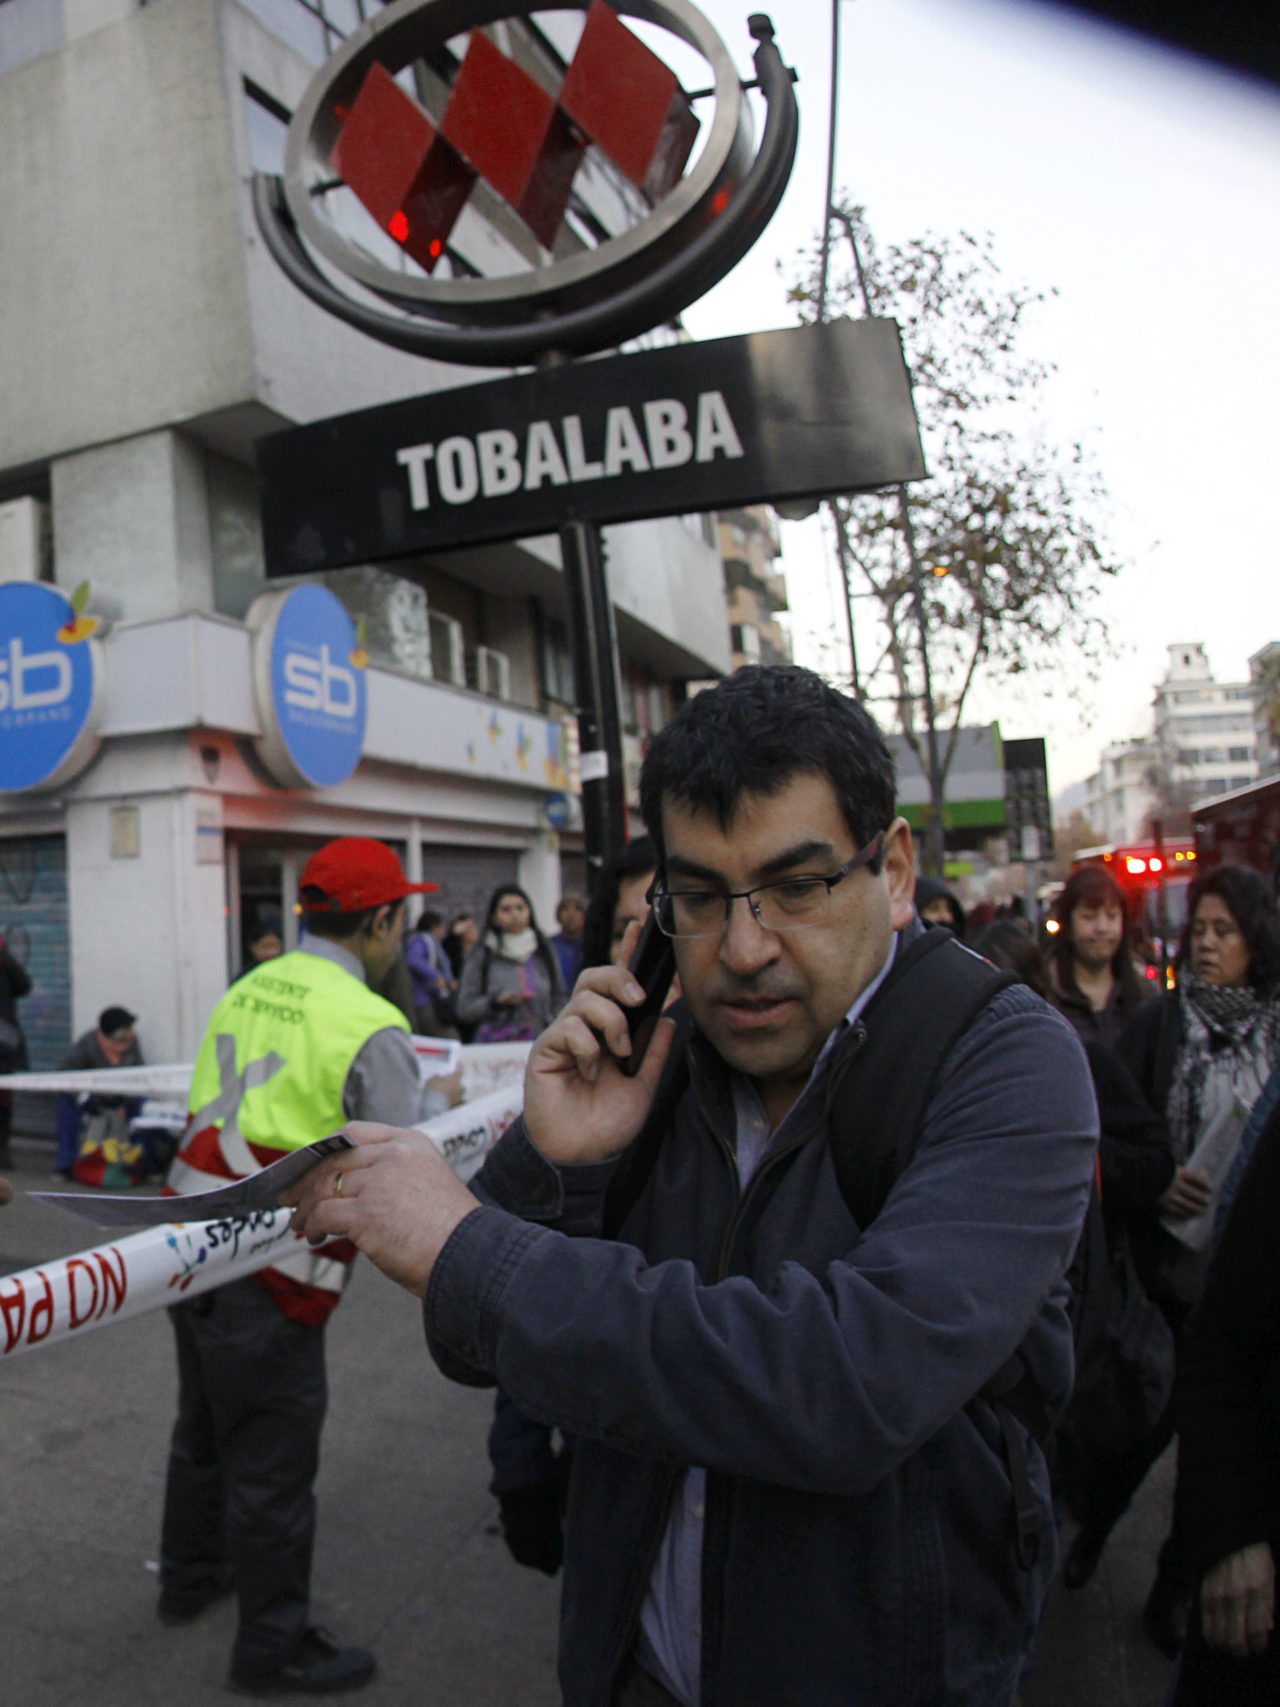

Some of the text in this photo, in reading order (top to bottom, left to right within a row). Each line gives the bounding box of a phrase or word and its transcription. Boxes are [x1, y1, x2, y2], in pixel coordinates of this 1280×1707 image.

[396, 391, 743, 511] TOBALABA
[285, 642, 357, 718] sb
[66, 1246, 127, 1330] NO
